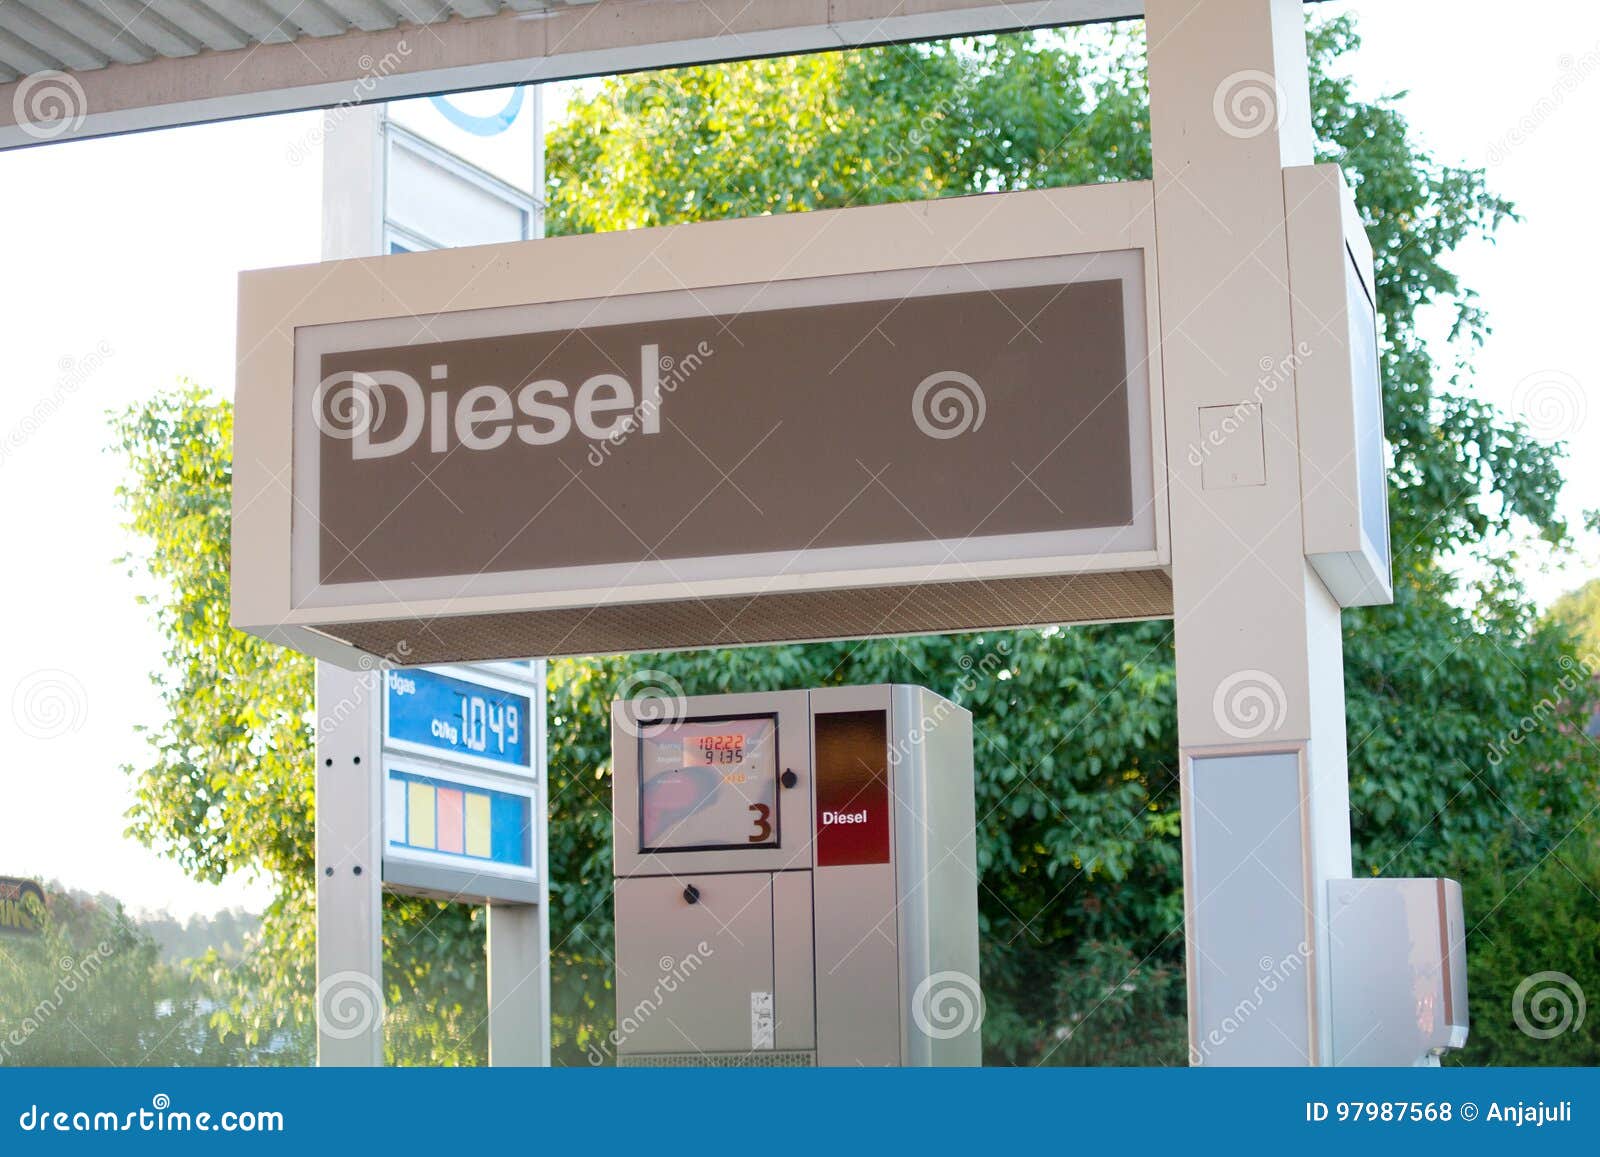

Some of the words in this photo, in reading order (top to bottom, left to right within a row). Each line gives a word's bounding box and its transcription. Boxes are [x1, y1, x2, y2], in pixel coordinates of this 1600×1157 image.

[352, 343, 661, 461] Diesel
[748, 803, 772, 842] 3
[823, 810, 867, 825] Diesel
